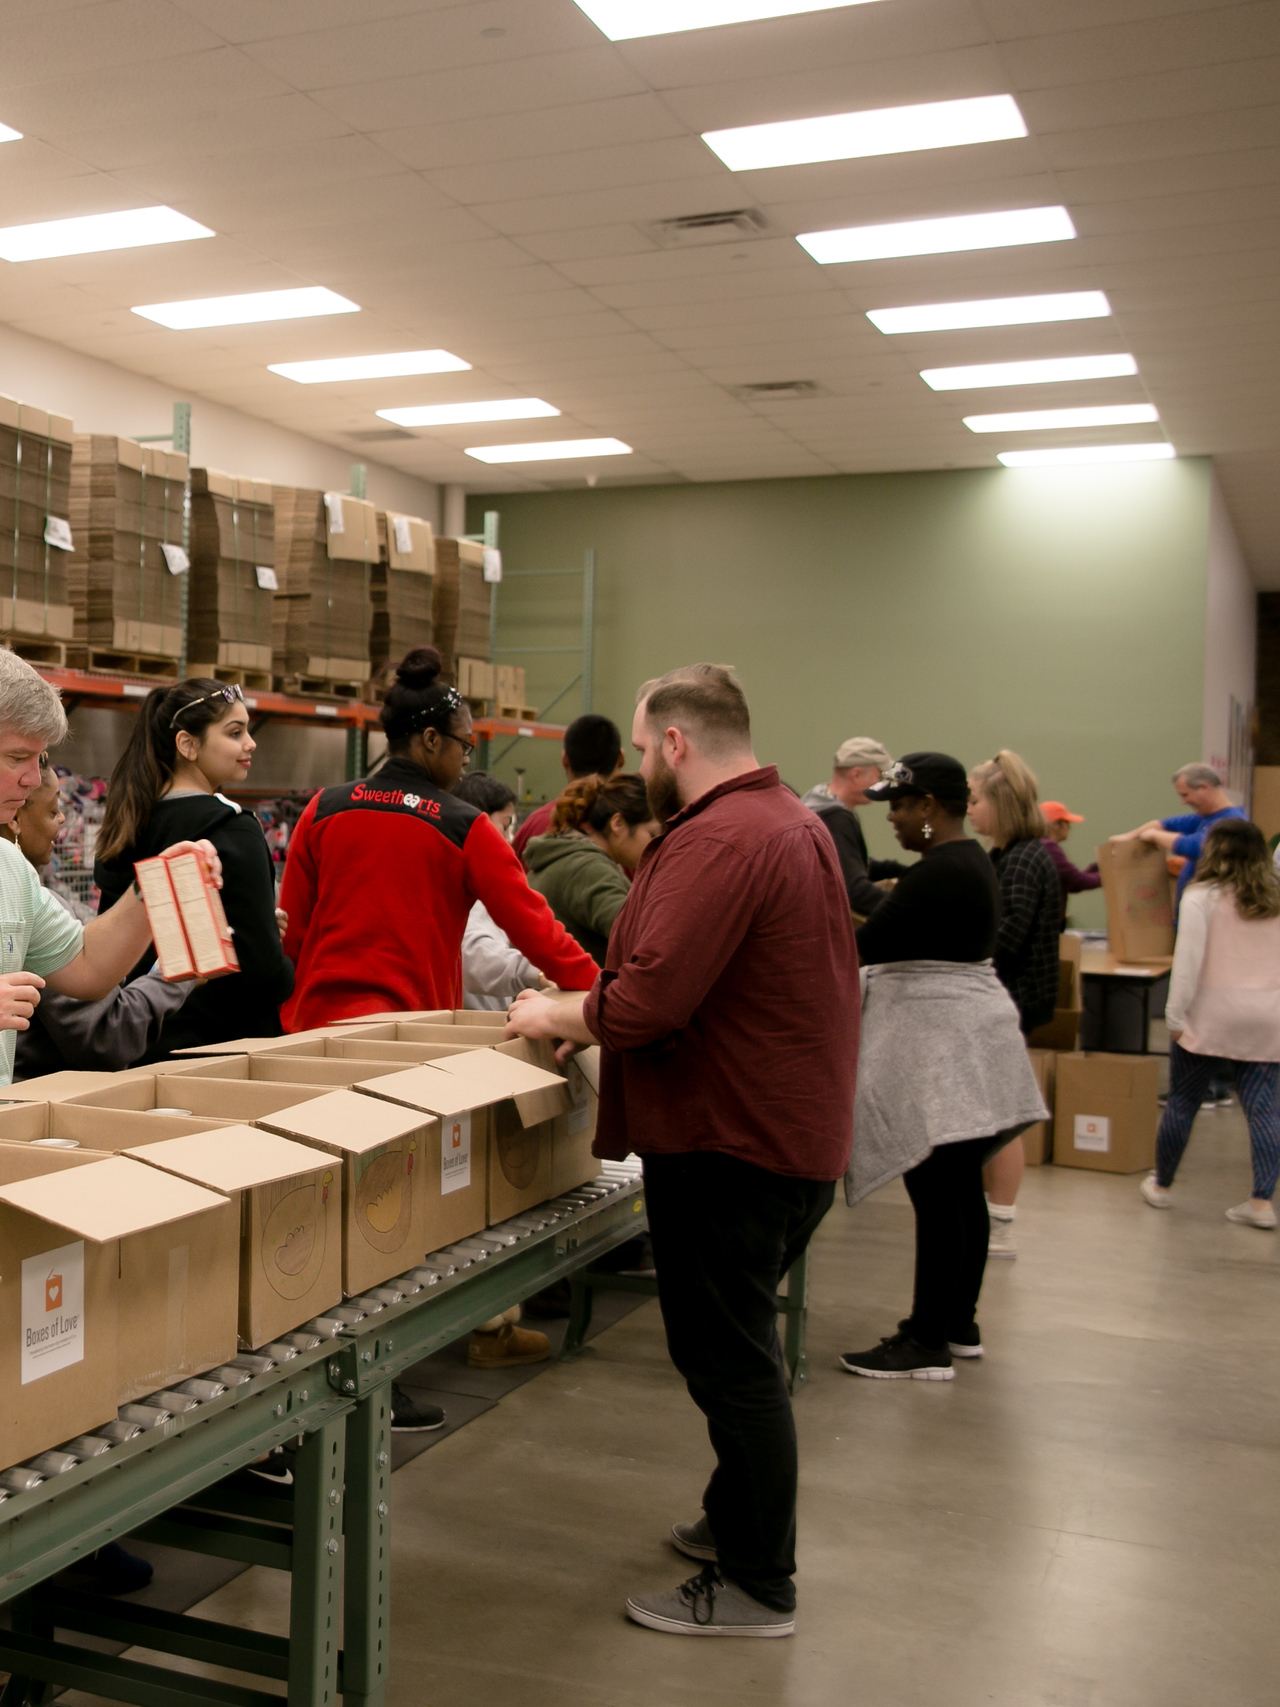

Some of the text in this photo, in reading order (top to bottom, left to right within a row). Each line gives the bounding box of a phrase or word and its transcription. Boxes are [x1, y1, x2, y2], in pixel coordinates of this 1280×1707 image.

[350, 783, 442, 815] Sweethearts
[26, 1327, 49, 1348] Boxes
[51, 1317, 59, 1338] of
[60, 1315, 78, 1334] Love
